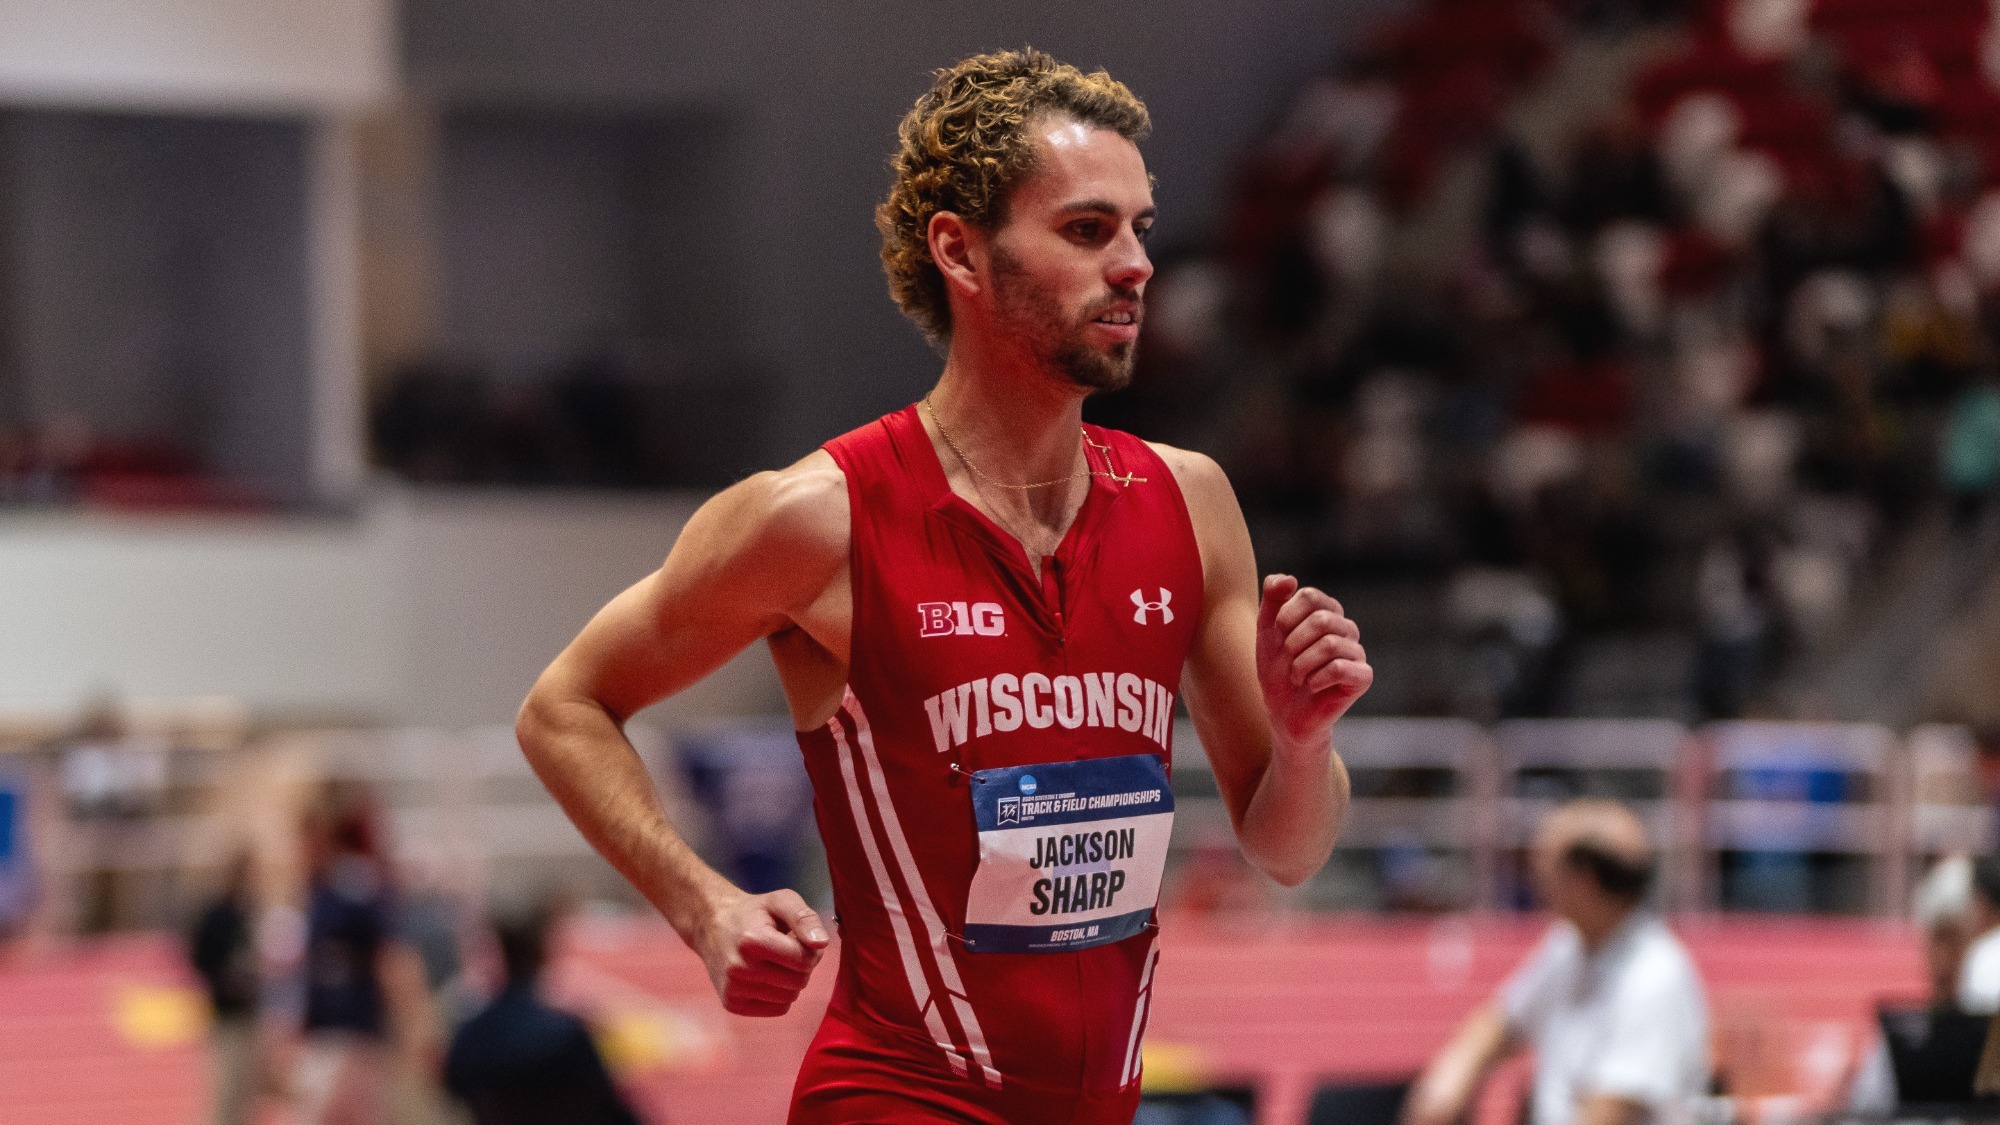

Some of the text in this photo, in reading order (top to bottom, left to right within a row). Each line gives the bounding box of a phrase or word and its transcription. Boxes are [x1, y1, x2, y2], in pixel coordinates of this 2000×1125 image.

[924, 672, 1174, 753] WISCONSIN
[1022, 789, 1161, 815] TRACK & FIELD CHAMPIONSHIPS
[1030, 828, 1135, 869] JACKSON
[1030, 869, 1126, 915] SHARP
[1050, 927, 1085, 942] BOSTON,
[1087, 925, 1099, 937] MA
